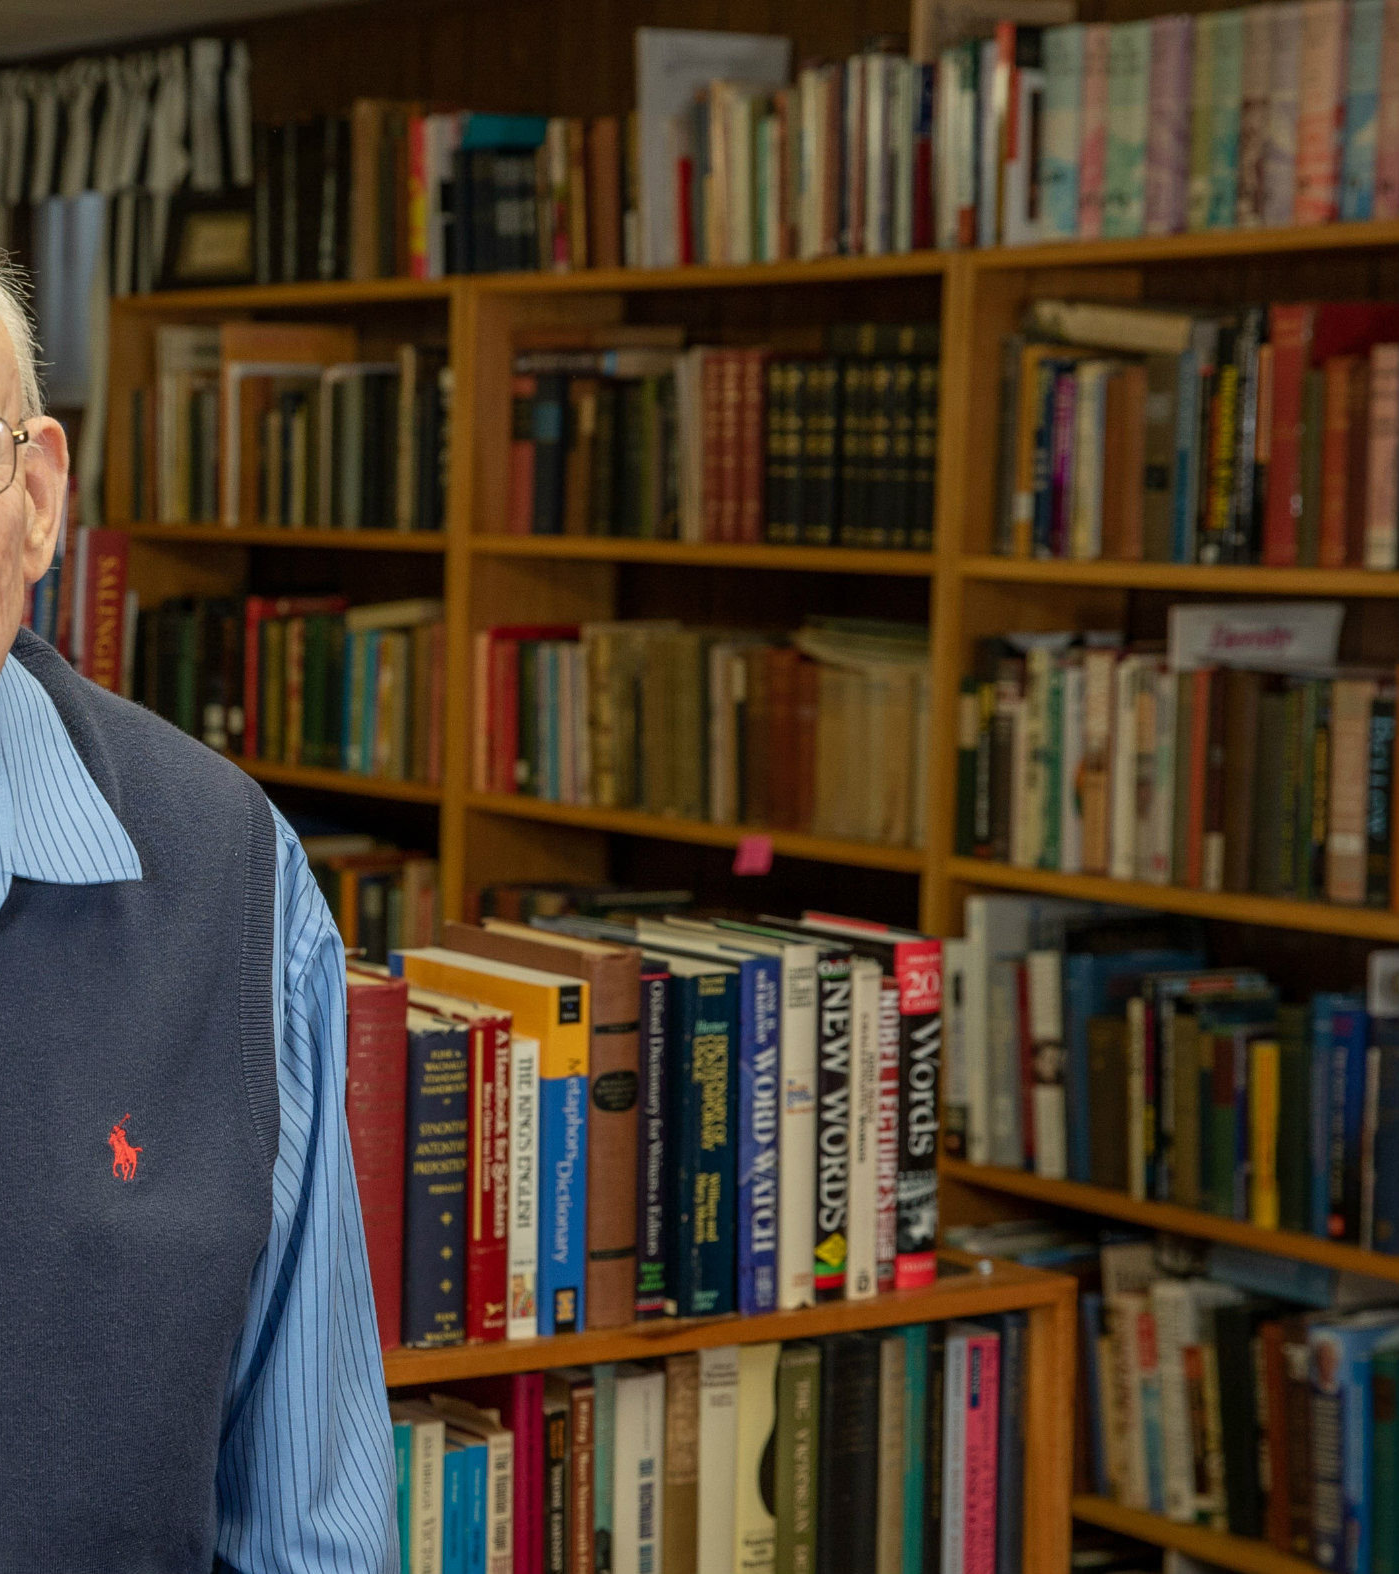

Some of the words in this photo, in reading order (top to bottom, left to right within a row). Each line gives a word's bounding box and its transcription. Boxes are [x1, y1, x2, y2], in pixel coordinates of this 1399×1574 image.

[495, 1030, 508, 1046] A
[648, 981, 666, 1035] Oxford
[821, 981, 850, 1075] NEW
[877, 989, 899, 1070] NOBEL
[494, 1048, 509, 1136] Handbook
[518, 1056, 534, 1089] THE
[562, 1058, 584, 1162] Metaphors
[644, 1037, 664, 1116] Dictionary
[752, 1045, 777, 1144] WORD
[907, 1018, 941, 1158] Words
[517, 1094, 533, 1153] KING'S
[819, 1087, 849, 1231] WORDS
[875, 1086, 899, 1211] LECTURES
[517, 1155, 533, 1230] ENGLISH
[551, 1160, 574, 1264] Dictionary
[647, 1204, 663, 1256] Editors
[750, 1148, 777, 1253] WATCH
